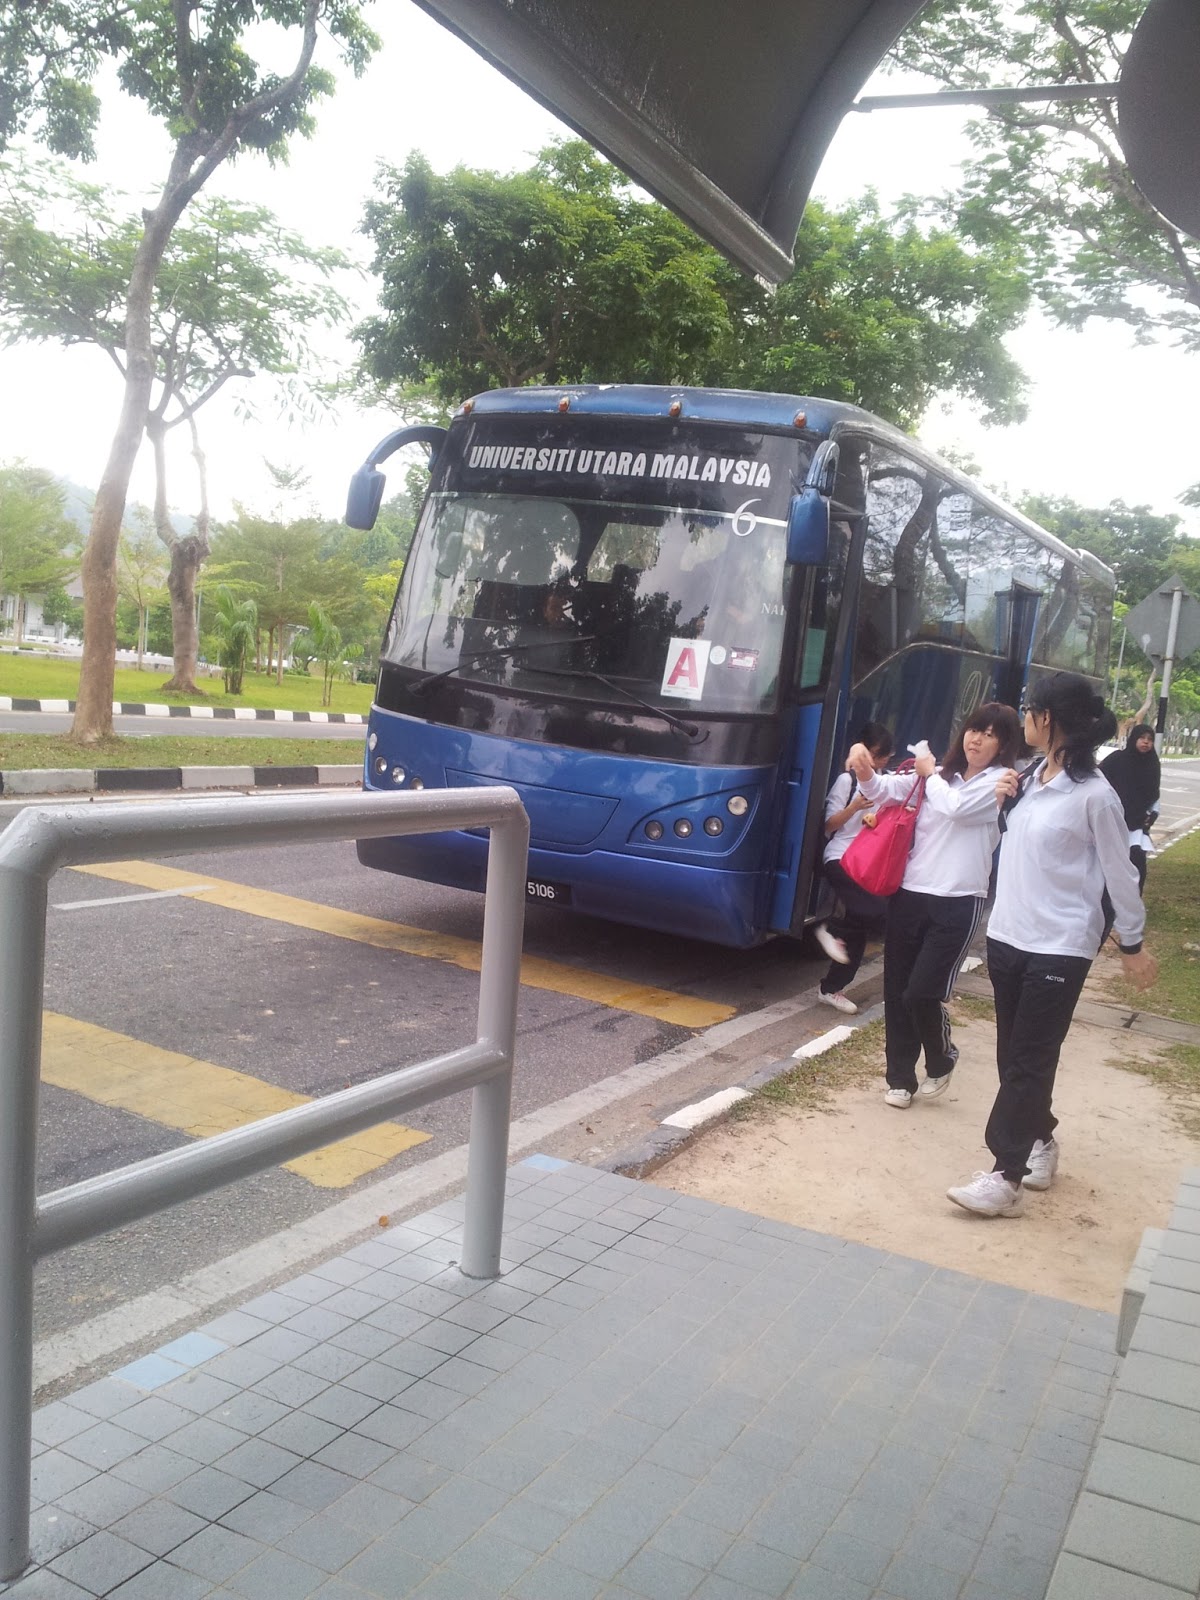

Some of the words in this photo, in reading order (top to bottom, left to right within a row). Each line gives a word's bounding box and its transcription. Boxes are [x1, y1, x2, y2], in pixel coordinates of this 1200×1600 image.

[468, 446, 577, 472] UNIVERSITI
[577, 450, 646, 476] UTARA
[650, 454, 771, 488] MALAYSIA
[732, 498, 762, 537] 6
[667, 647, 699, 689] A
[527, 881, 555, 899] 5106
